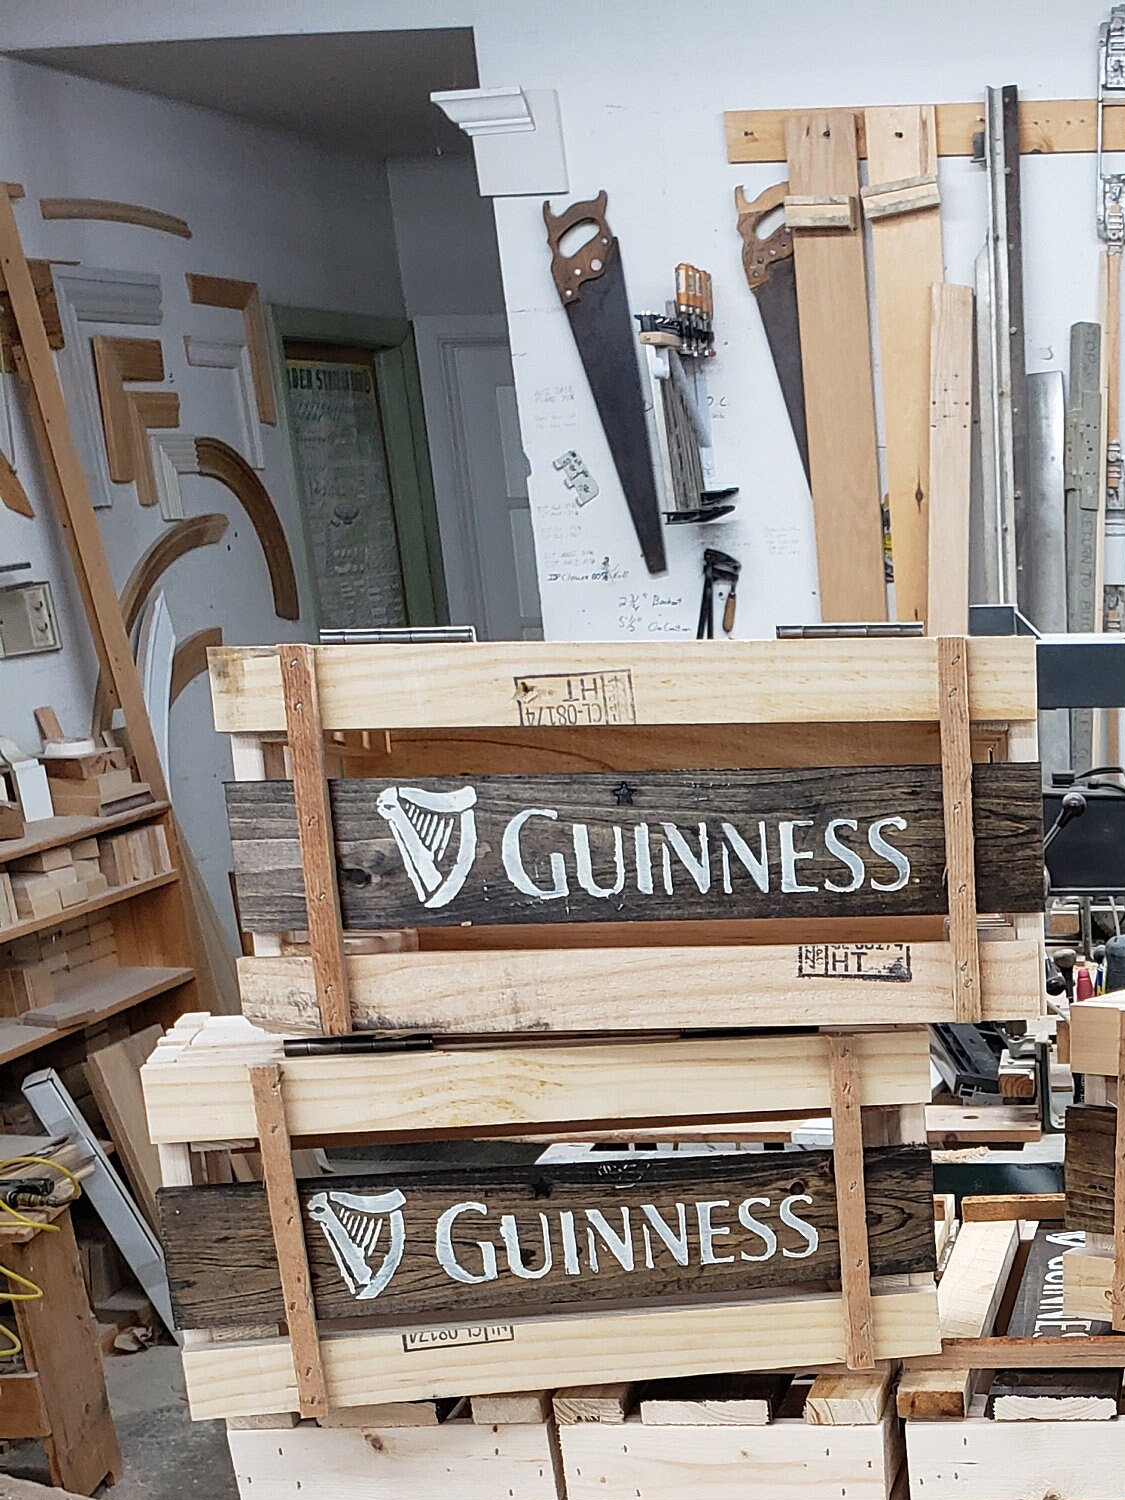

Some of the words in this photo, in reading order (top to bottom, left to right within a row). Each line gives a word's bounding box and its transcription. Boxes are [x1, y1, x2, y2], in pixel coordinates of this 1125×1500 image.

[562, 678, 598, 702] HT
[502, 808, 909, 900] GUINNESS
[436, 1194, 819, 1283] GUINNESS
